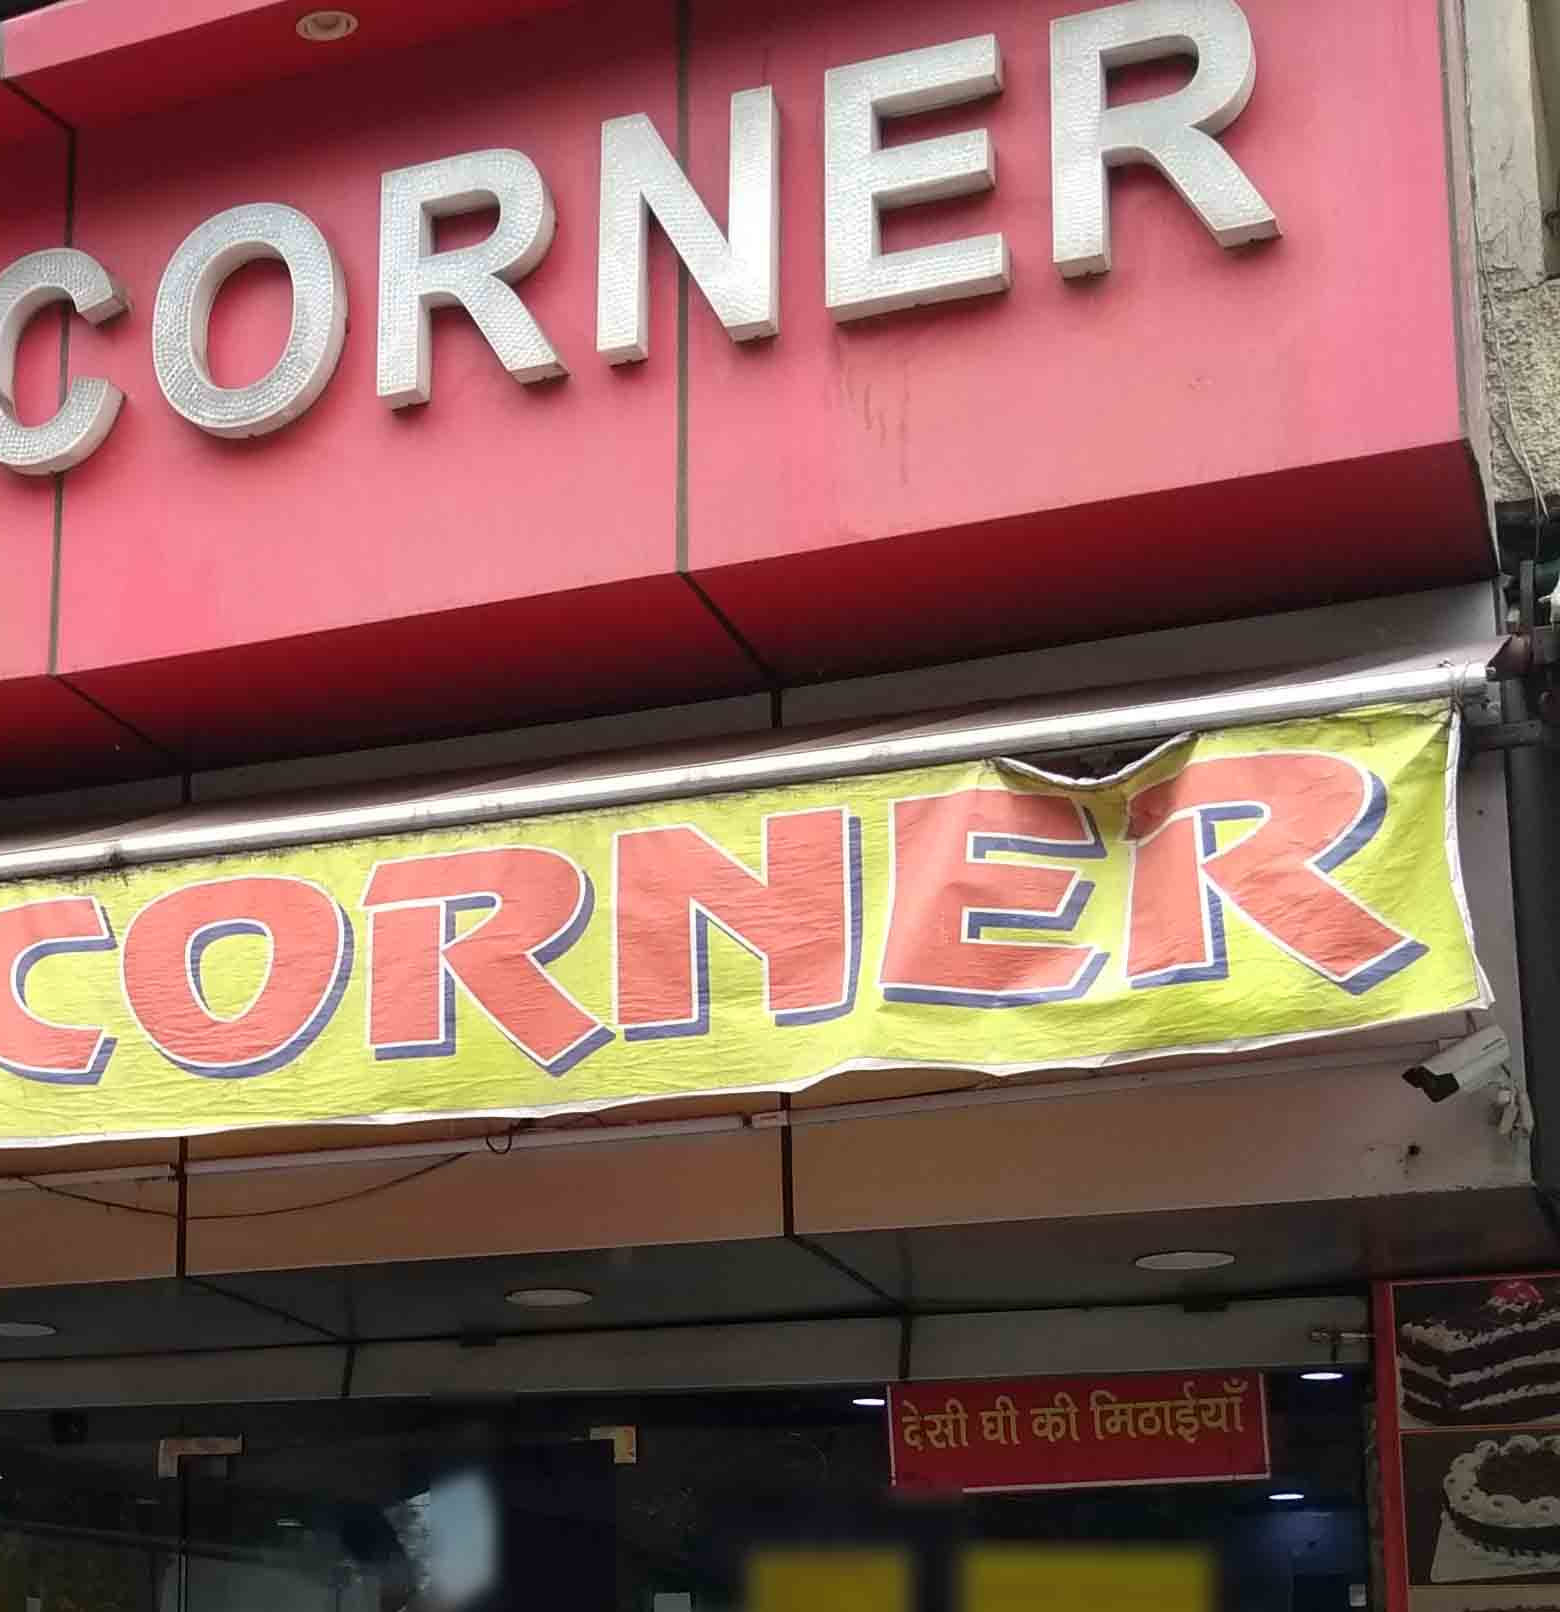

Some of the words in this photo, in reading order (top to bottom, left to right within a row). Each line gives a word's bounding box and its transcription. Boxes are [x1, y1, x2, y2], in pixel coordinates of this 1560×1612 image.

[902, 1398, 969, 1450] देसी
[979, 1394, 1021, 1445] घी
[1030, 1391, 1081, 1442] की
[1089, 1378, 1249, 1444] मिठाईयाँ
